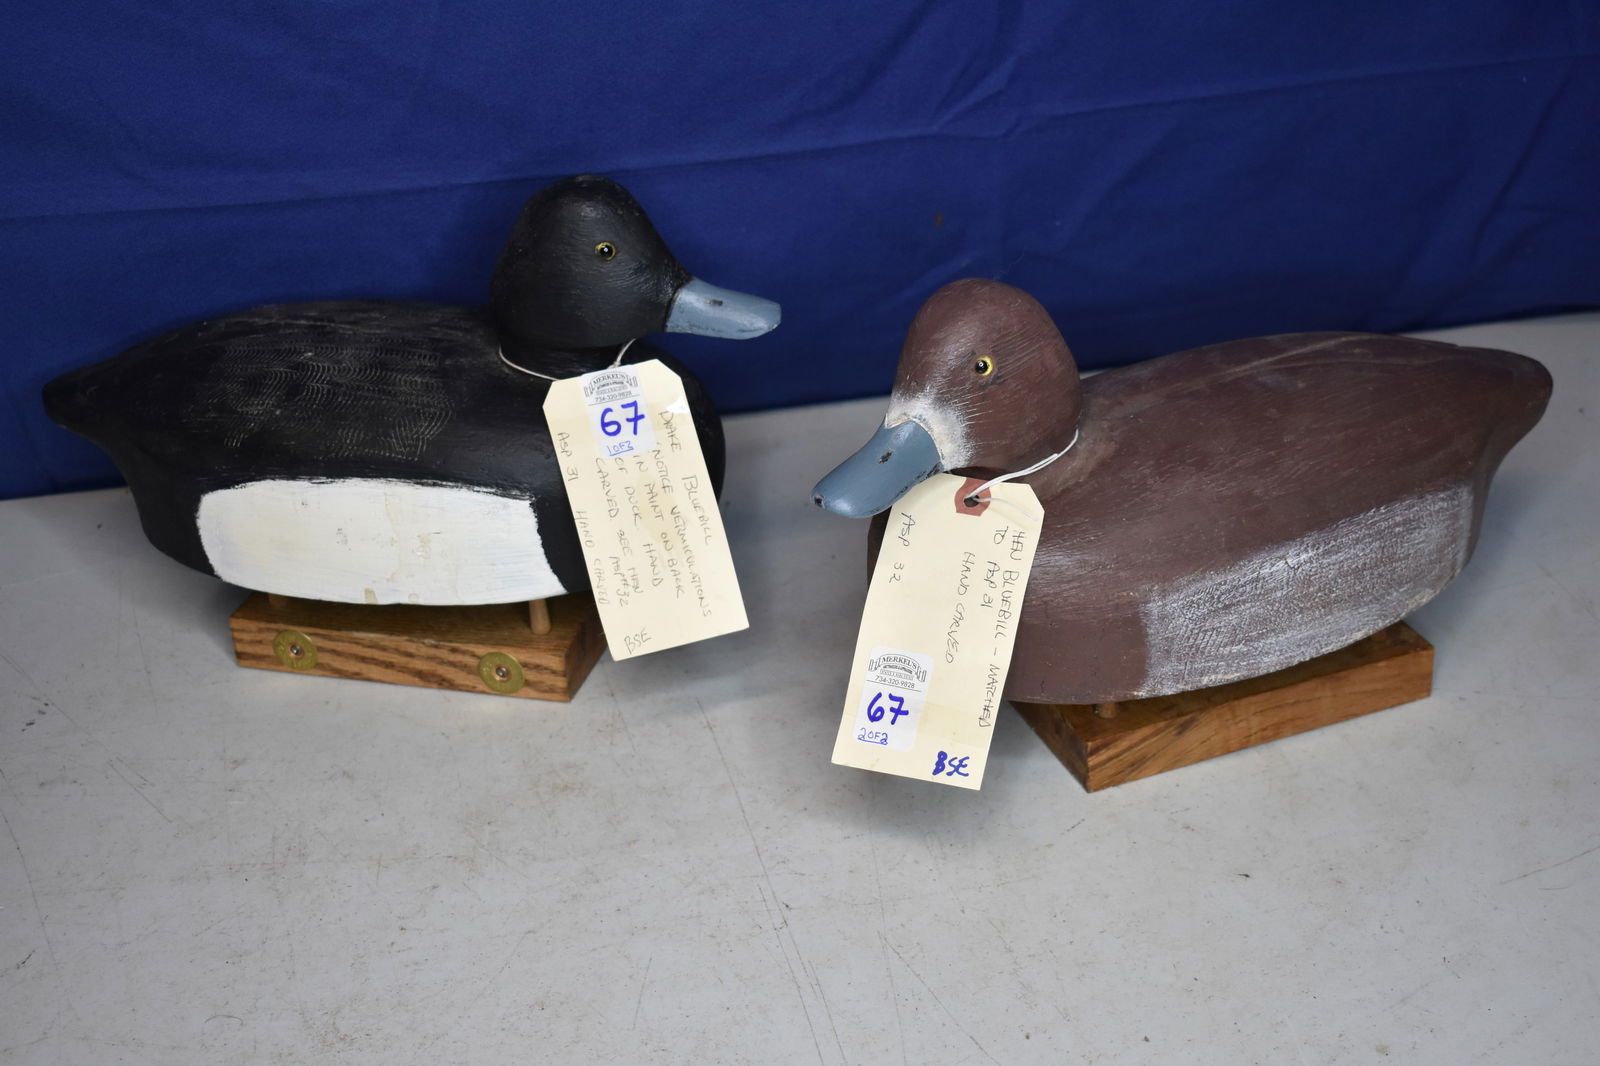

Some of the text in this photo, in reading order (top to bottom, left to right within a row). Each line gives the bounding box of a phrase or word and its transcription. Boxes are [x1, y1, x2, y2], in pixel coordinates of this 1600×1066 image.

[600, 400, 645, 437] 67
[557, 432, 573, 458] ASP
[567, 466, 578, 482] 31
[575, 510, 595, 548] HAND
[659, 410, 713, 546] DRAKE BLUEBILL
[614, 457, 628, 474] OF
[643, 543, 664, 586] HAND
[644, 483, 664, 521] PAINT
[660, 532, 674, 552] ON
[667, 558, 685, 599] BACK
[889, 512, 916, 584] ASP 32
[981, 526, 1009, 608] TO ASP 31
[945, 551, 976, 663] HAND CARVED
[995, 570, 1019, 639] BLUEBILL
[624, 627, 652, 654] BSE
[881, 656, 917, 670] MERKEL'S
[866, 692, 909, 725] 67
[875, 675, 916, 689] 734-320-9828
[978, 663, 1000, 728] MATCHED
[932, 750, 970, 777] BSE
